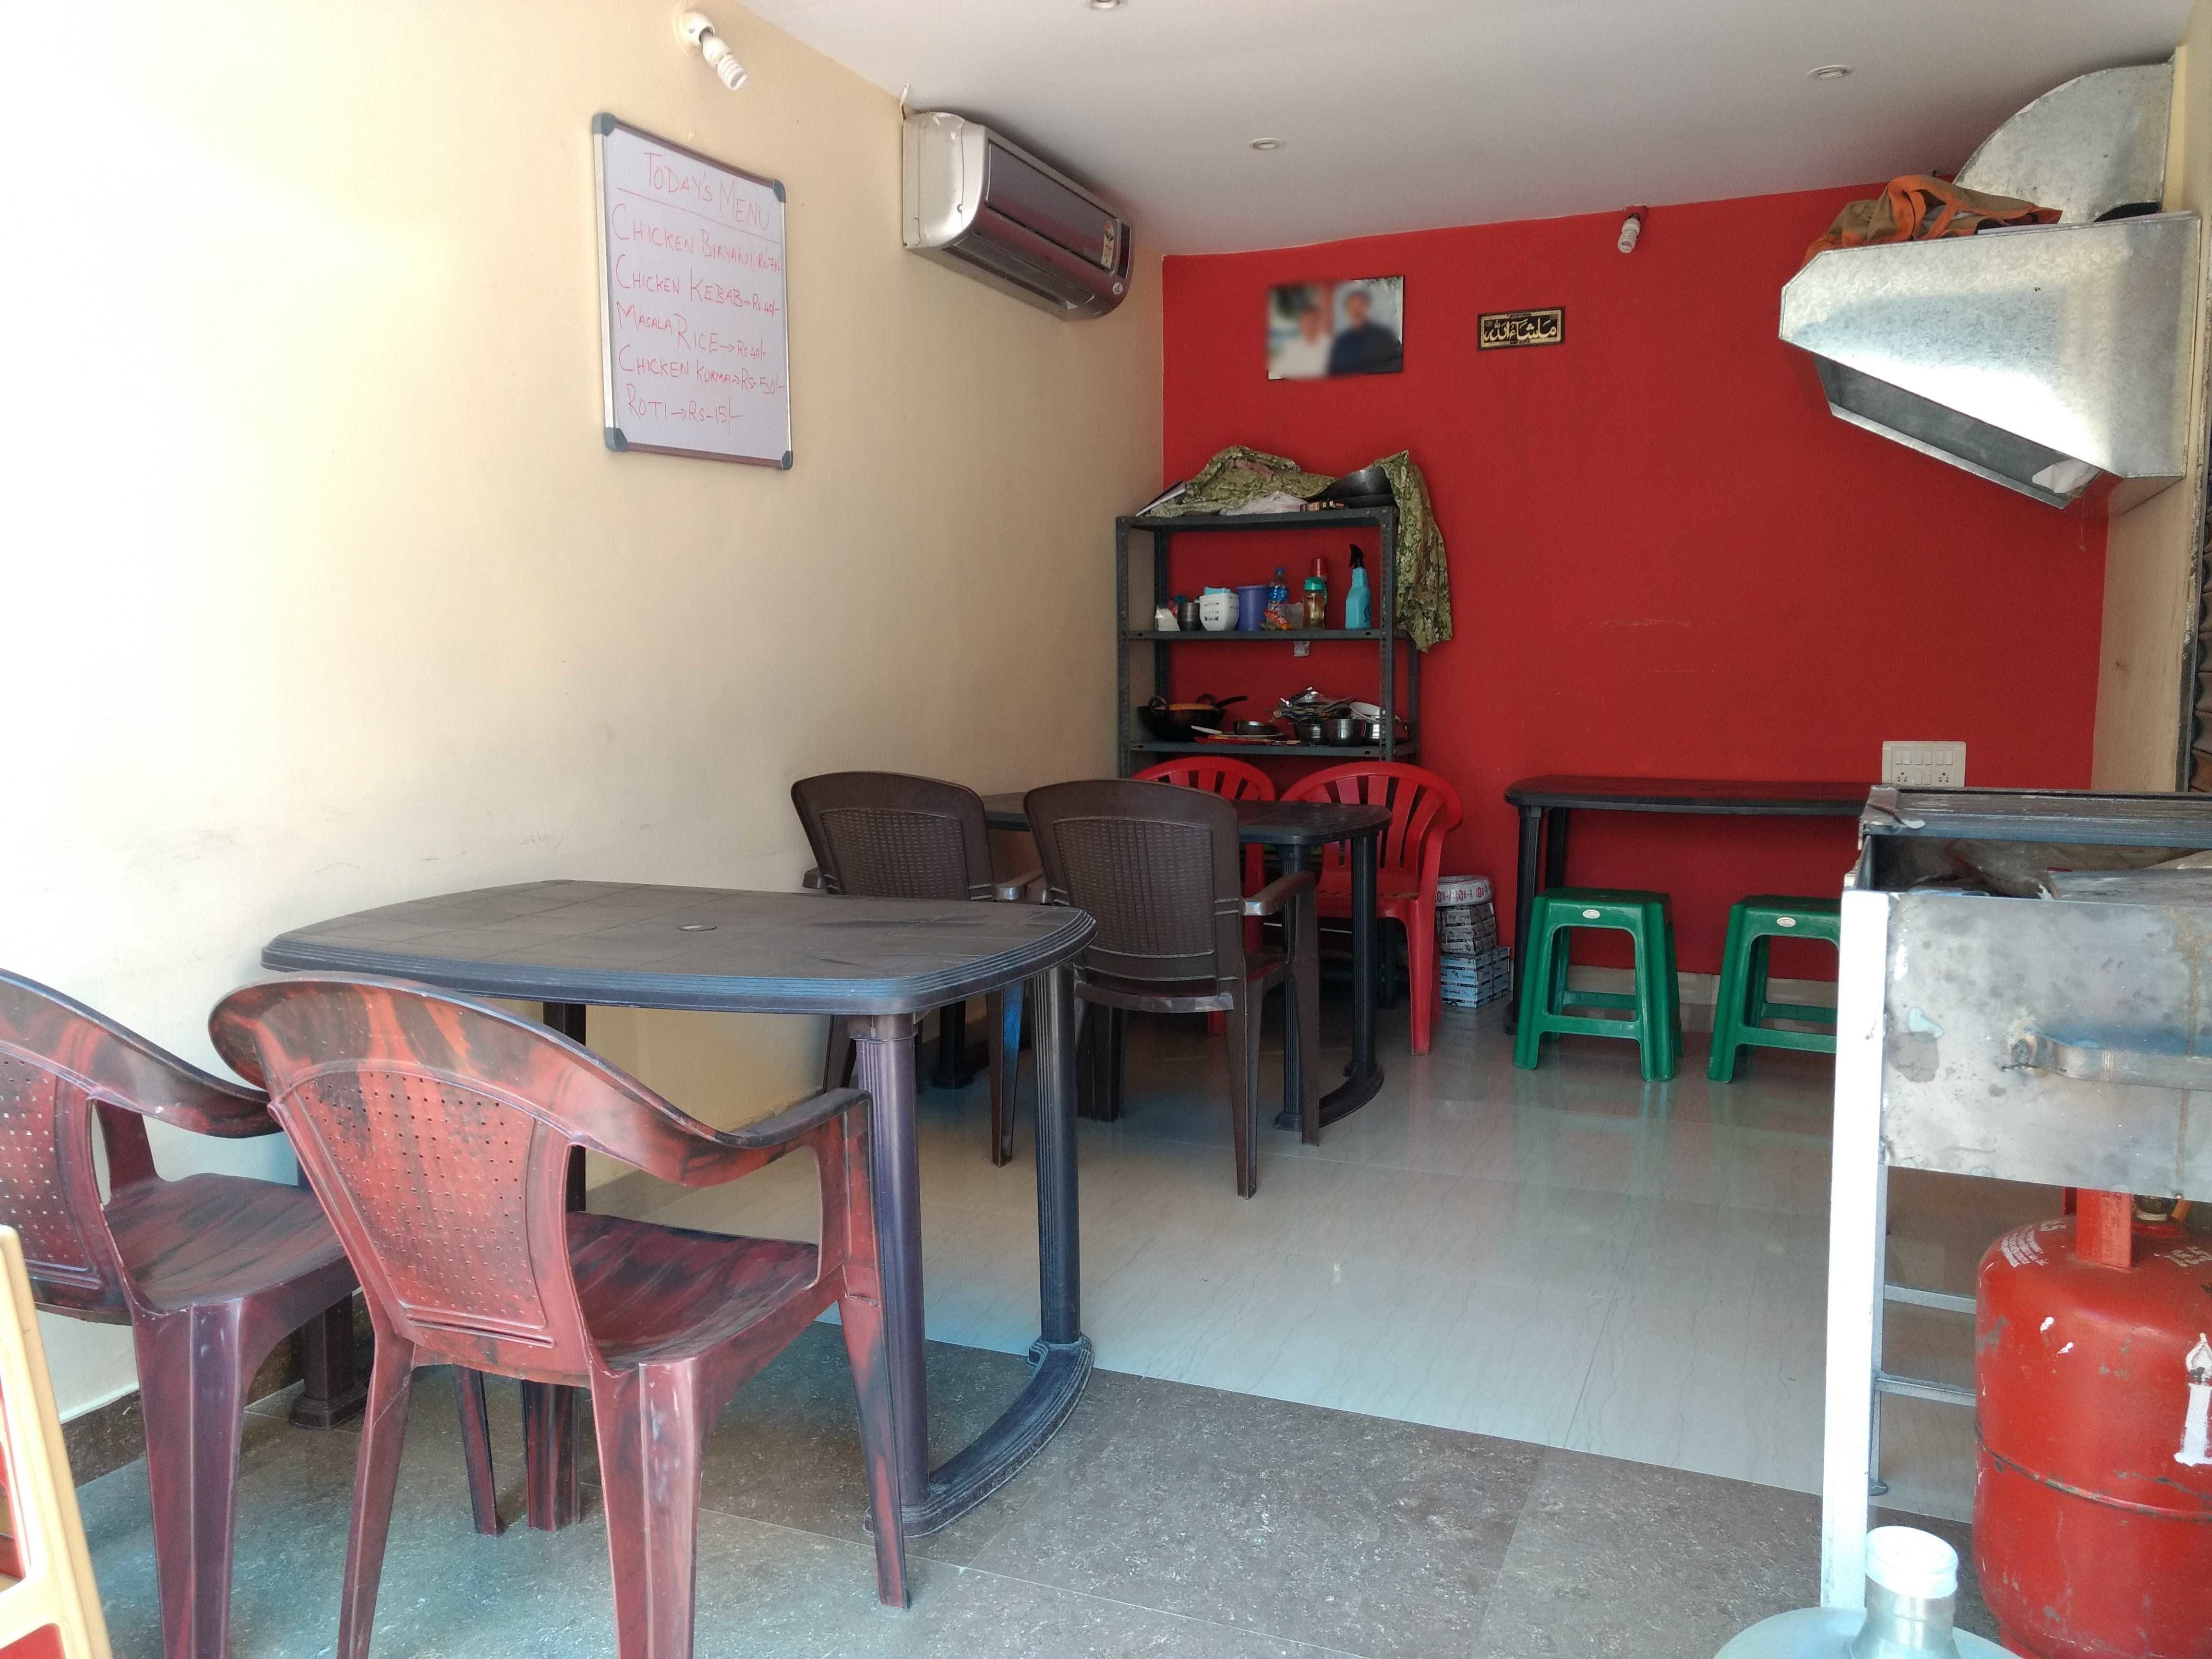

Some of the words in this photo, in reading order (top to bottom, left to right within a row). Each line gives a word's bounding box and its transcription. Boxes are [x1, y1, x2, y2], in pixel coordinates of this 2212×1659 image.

[720, 180, 769, 230] MENU
[612, 204, 694, 254] CHICKEN
[700, 228, 753, 266] BIRYANI
[616, 253, 680, 295] CHICKEN
[691, 268, 743, 307] KEBAB
[616, 301, 673, 335] MASALA
[674, 313, 719, 353] RICE
[619, 344, 689, 378] CHICKEN
[626, 383, 668, 420] ROTI
